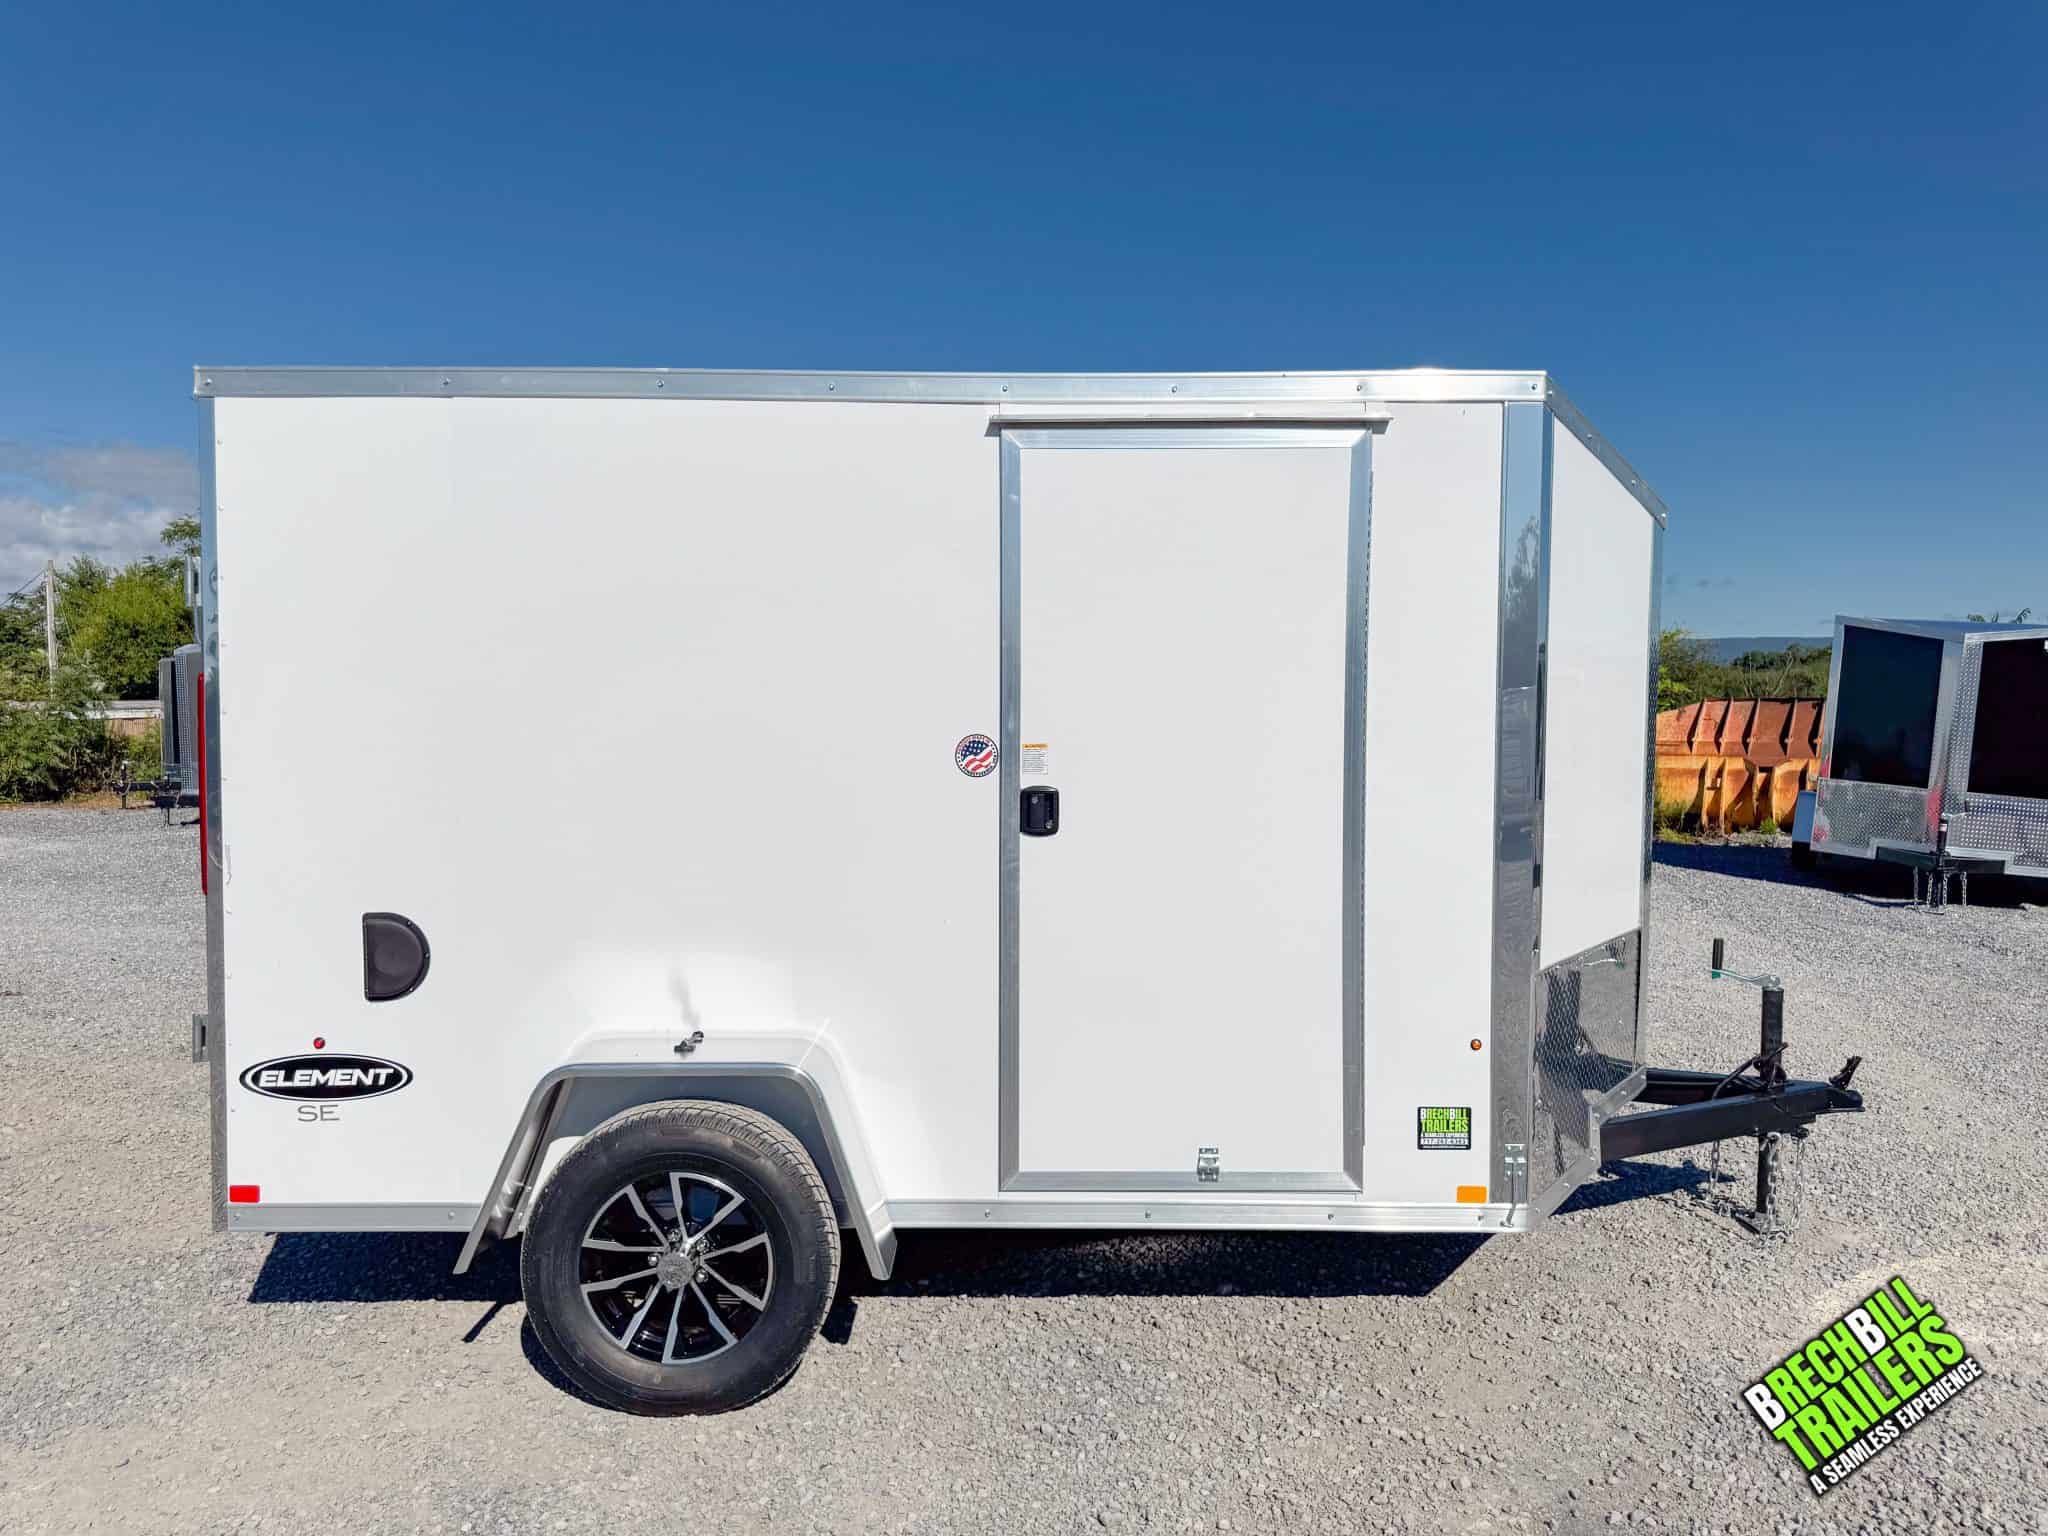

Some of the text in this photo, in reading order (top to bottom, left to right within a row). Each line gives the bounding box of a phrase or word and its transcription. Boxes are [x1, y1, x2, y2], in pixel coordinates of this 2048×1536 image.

[258, 1068, 394, 1088] ELEMENT
[297, 1104, 340, 1122] SE
[1421, 1119, 1469, 1132] TRAILERS
